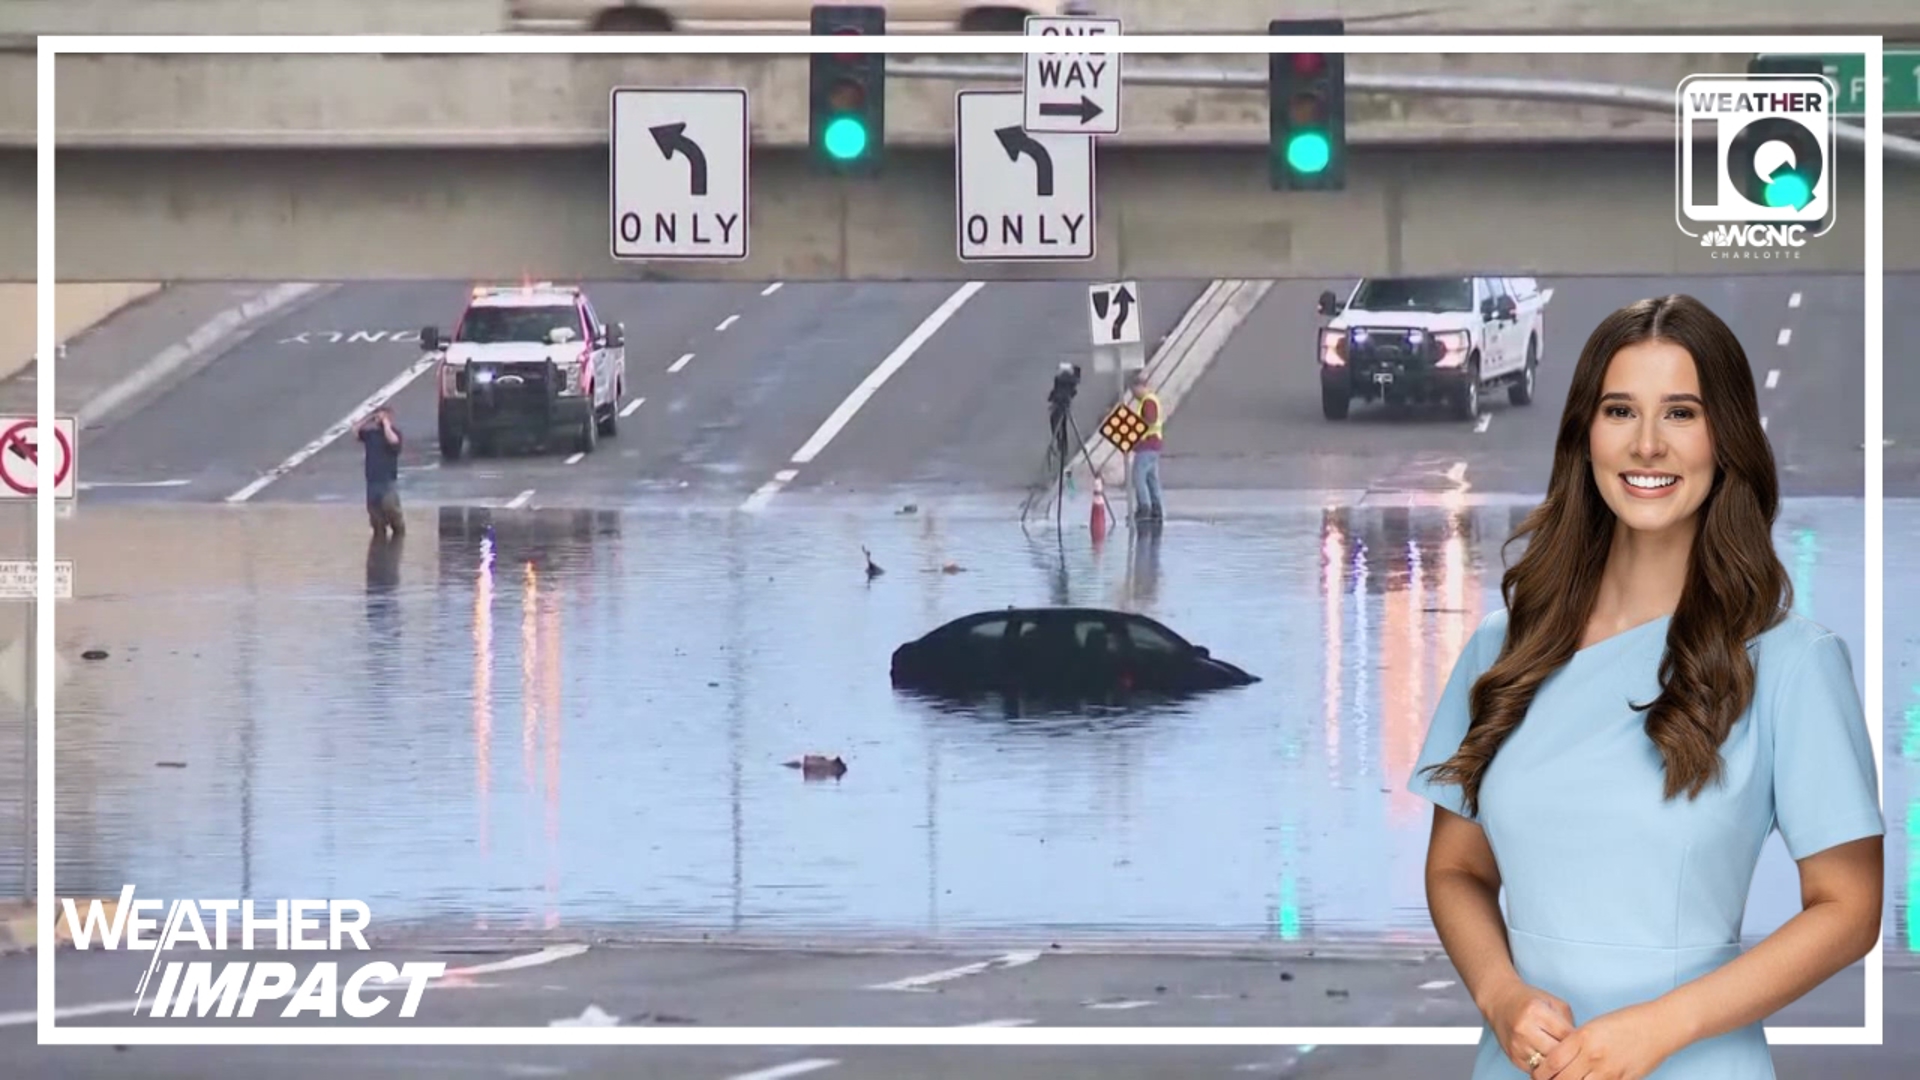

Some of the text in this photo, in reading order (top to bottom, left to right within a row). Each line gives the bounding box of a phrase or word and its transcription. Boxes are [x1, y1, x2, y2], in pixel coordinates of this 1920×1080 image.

[1038, 60, 1106, 88] WAY
[620, 212, 738, 243] ONLY
[967, 214, 1084, 244] ONLY
